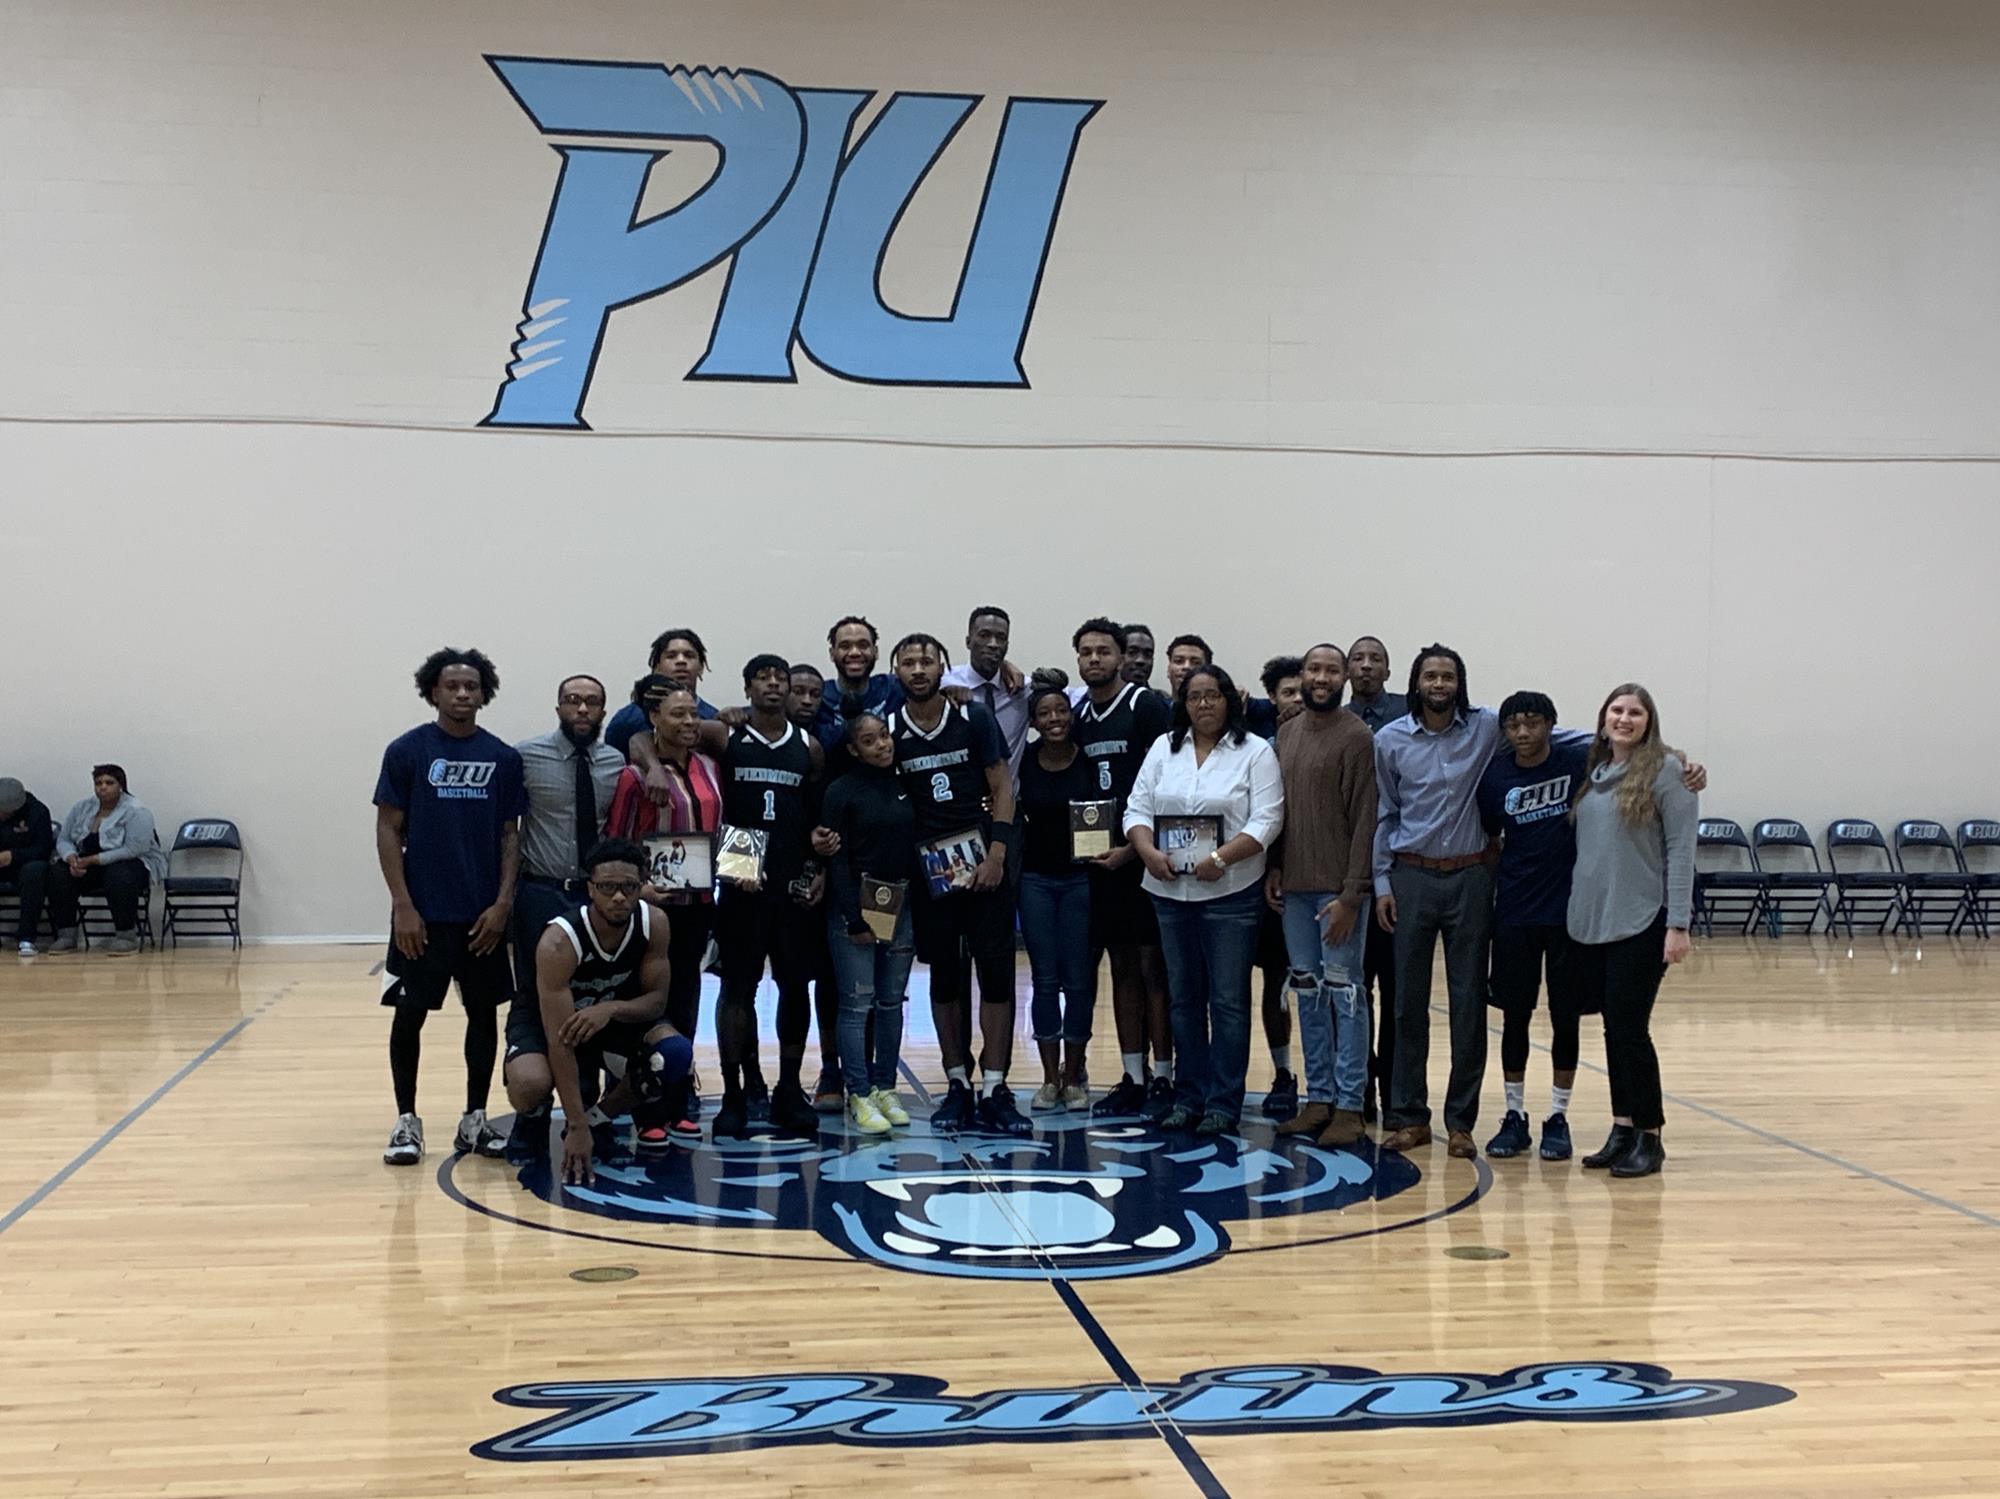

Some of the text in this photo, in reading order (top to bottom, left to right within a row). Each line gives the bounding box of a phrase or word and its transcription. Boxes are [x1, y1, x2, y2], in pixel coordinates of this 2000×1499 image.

[475, 54, 1107, 430] PIU
[440, 761, 496, 787] PIU
[931, 772, 953, 802] 2
[1098, 761, 1112, 790] 5
[437, 788, 488, 798] BASKETBALL
[763, 790, 775, 820] 1
[1517, 775, 1571, 814] PIU
[1515, 803, 1570, 824] BASKETBALL
[470, 1362, 1796, 1461] Bruins
